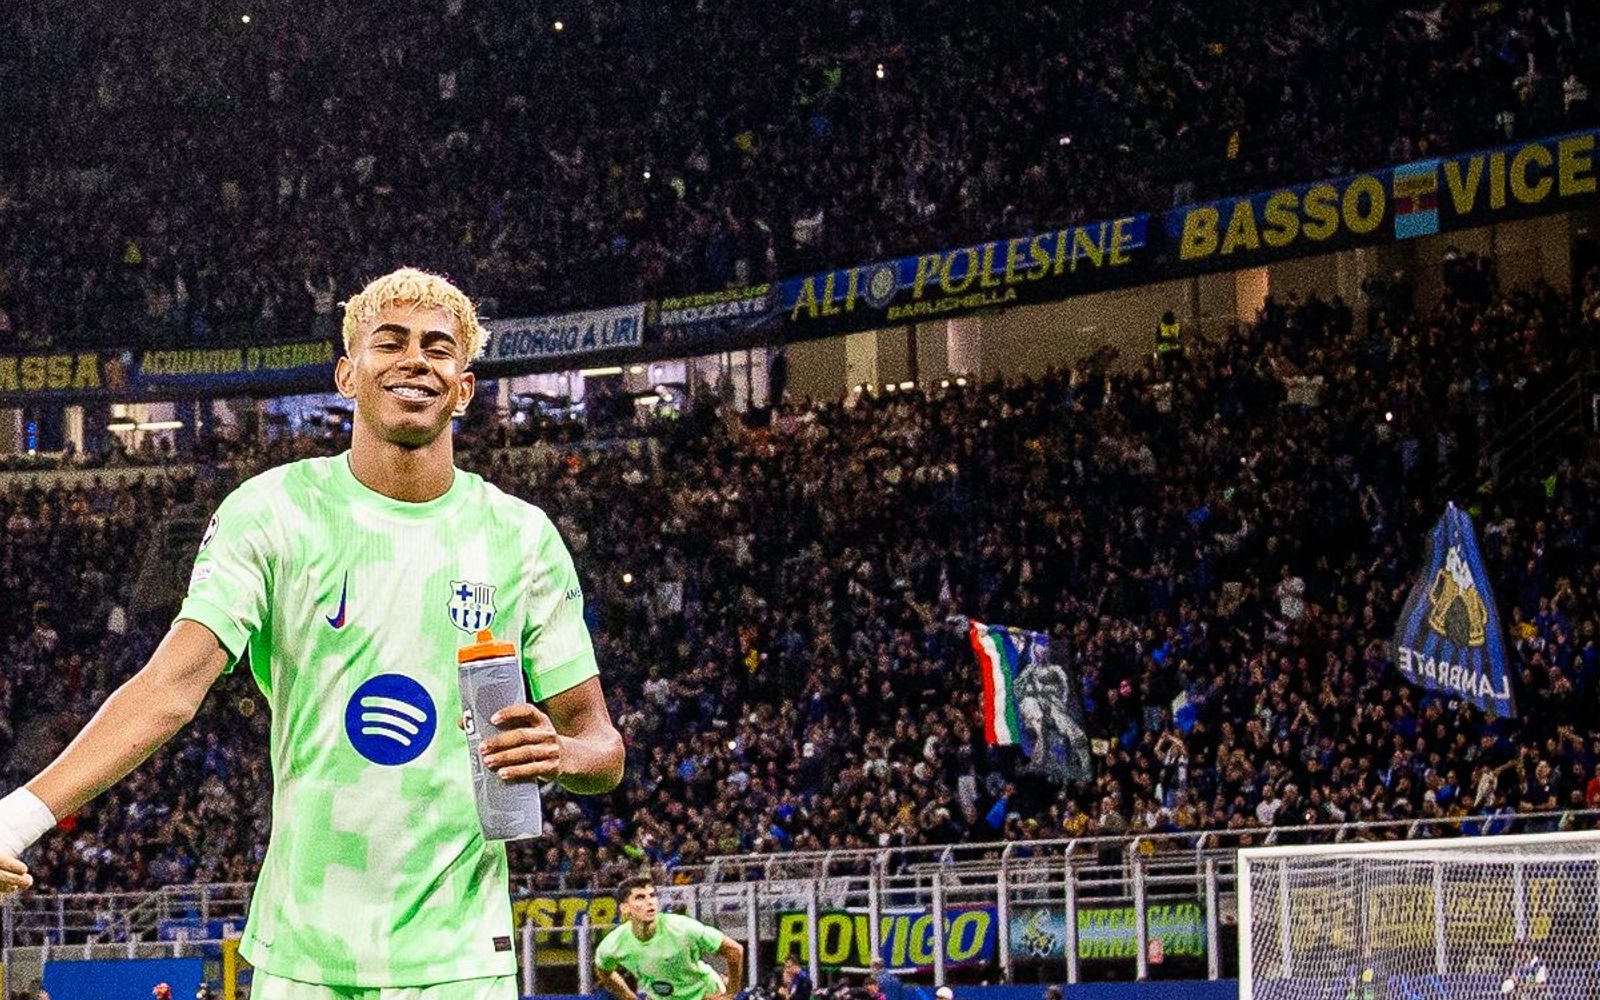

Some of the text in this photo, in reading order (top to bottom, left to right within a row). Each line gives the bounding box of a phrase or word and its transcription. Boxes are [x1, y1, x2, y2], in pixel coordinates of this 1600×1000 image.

[1179, 135, 1598, 261] BASSO VICE
[913, 217, 1136, 299] POLESINE
[776, 911, 991, 966] ROVIGO
[1077, 907, 1138, 930] NTER
